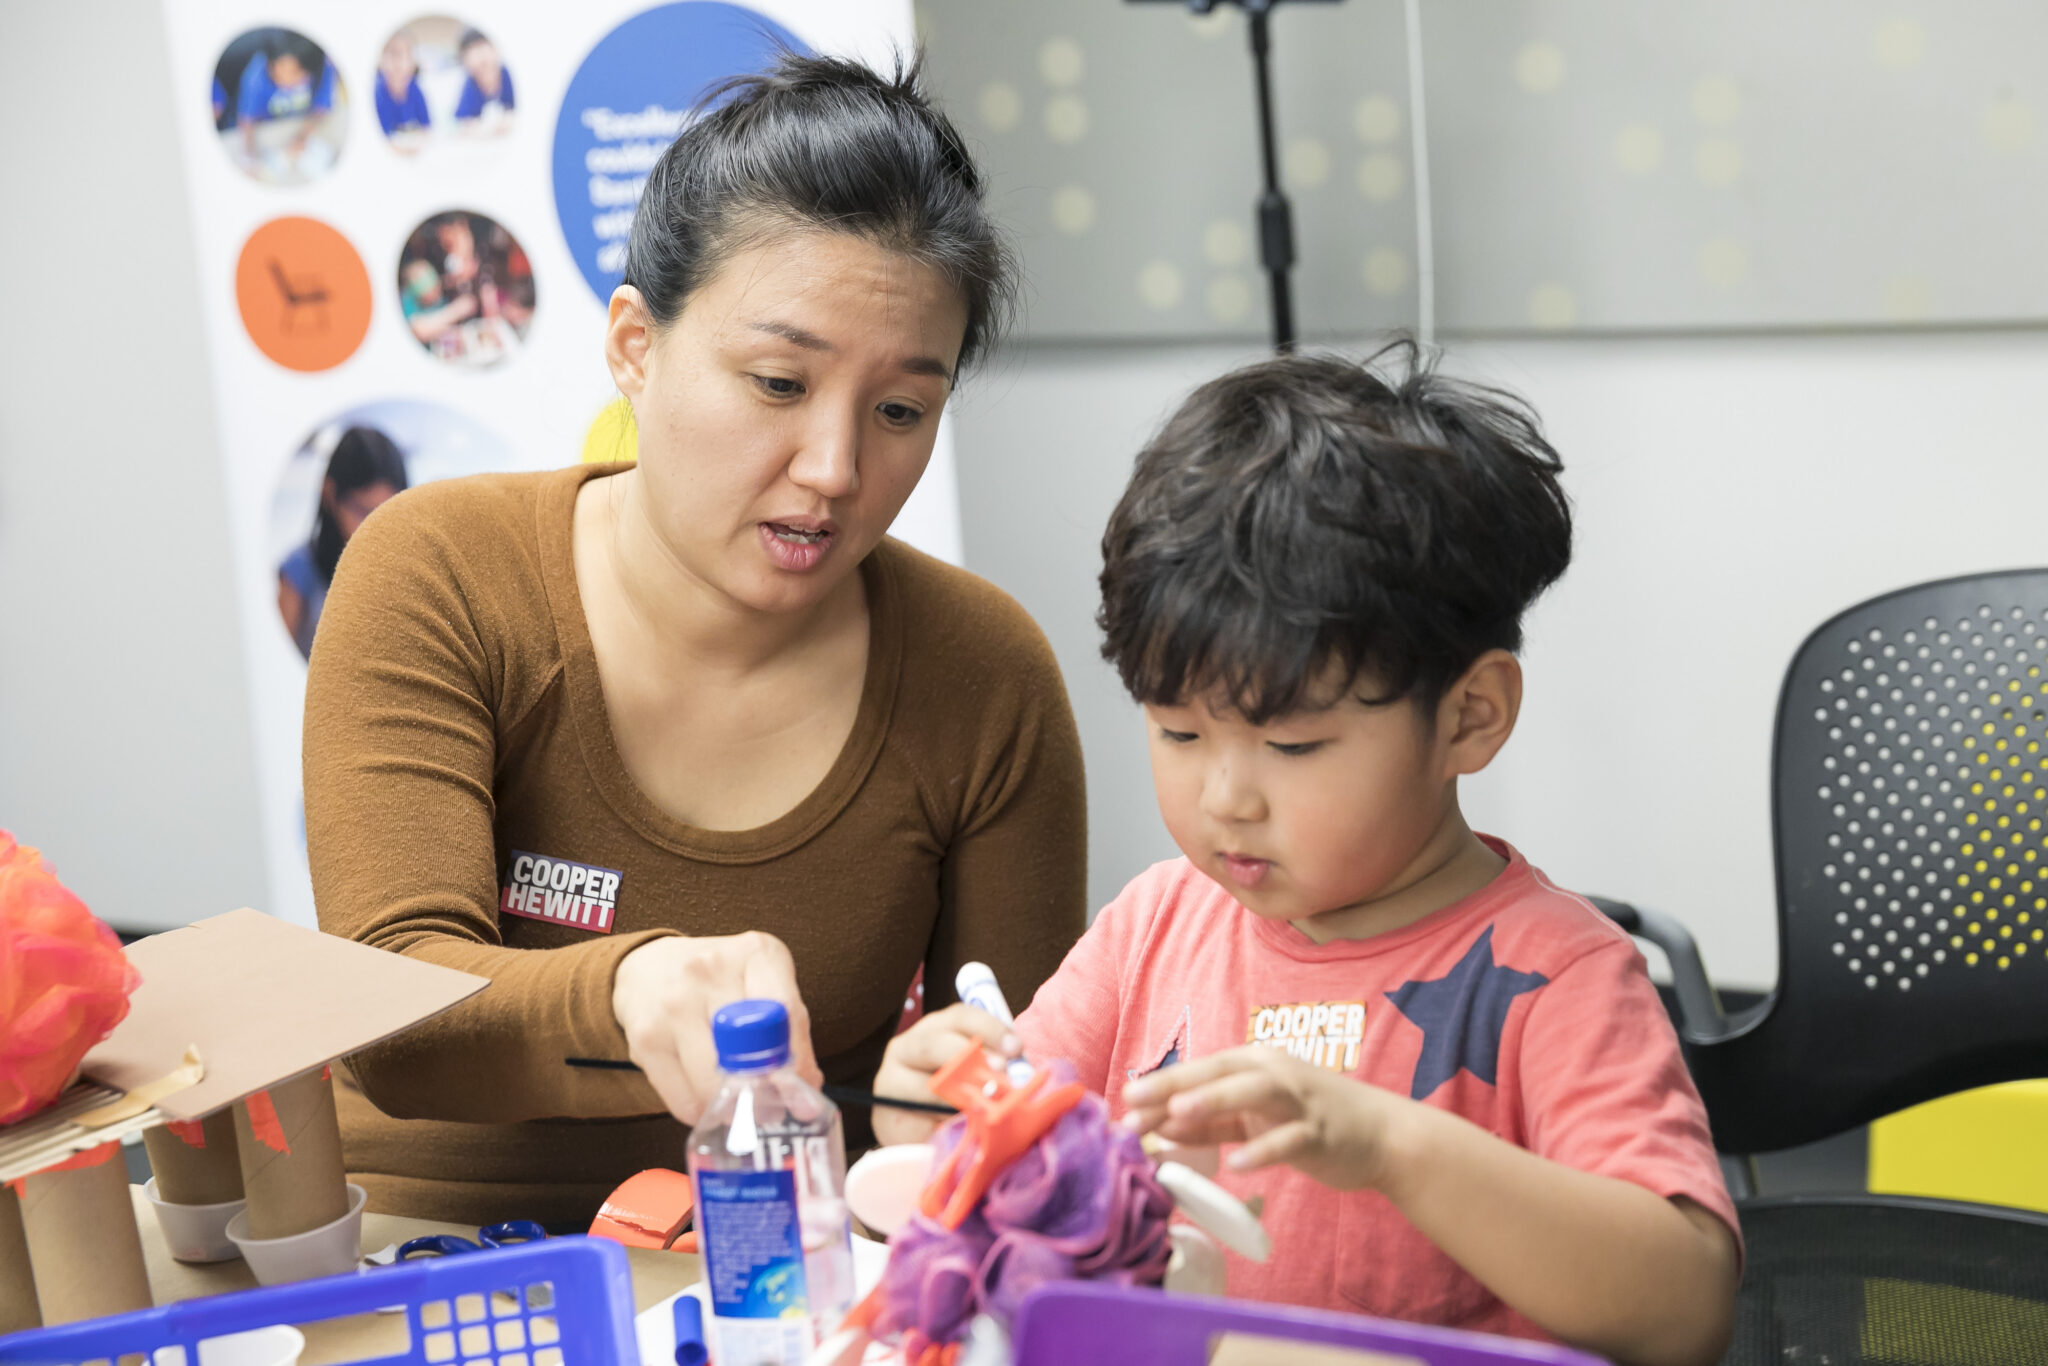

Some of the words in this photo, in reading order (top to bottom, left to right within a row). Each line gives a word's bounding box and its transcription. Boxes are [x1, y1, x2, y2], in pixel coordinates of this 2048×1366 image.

[513, 855, 620, 902] COOPER
[507, 881, 615, 928] HEWITT
[1254, 1003, 1366, 1041] COOPER
[1253, 1036, 1362, 1068] WITT
